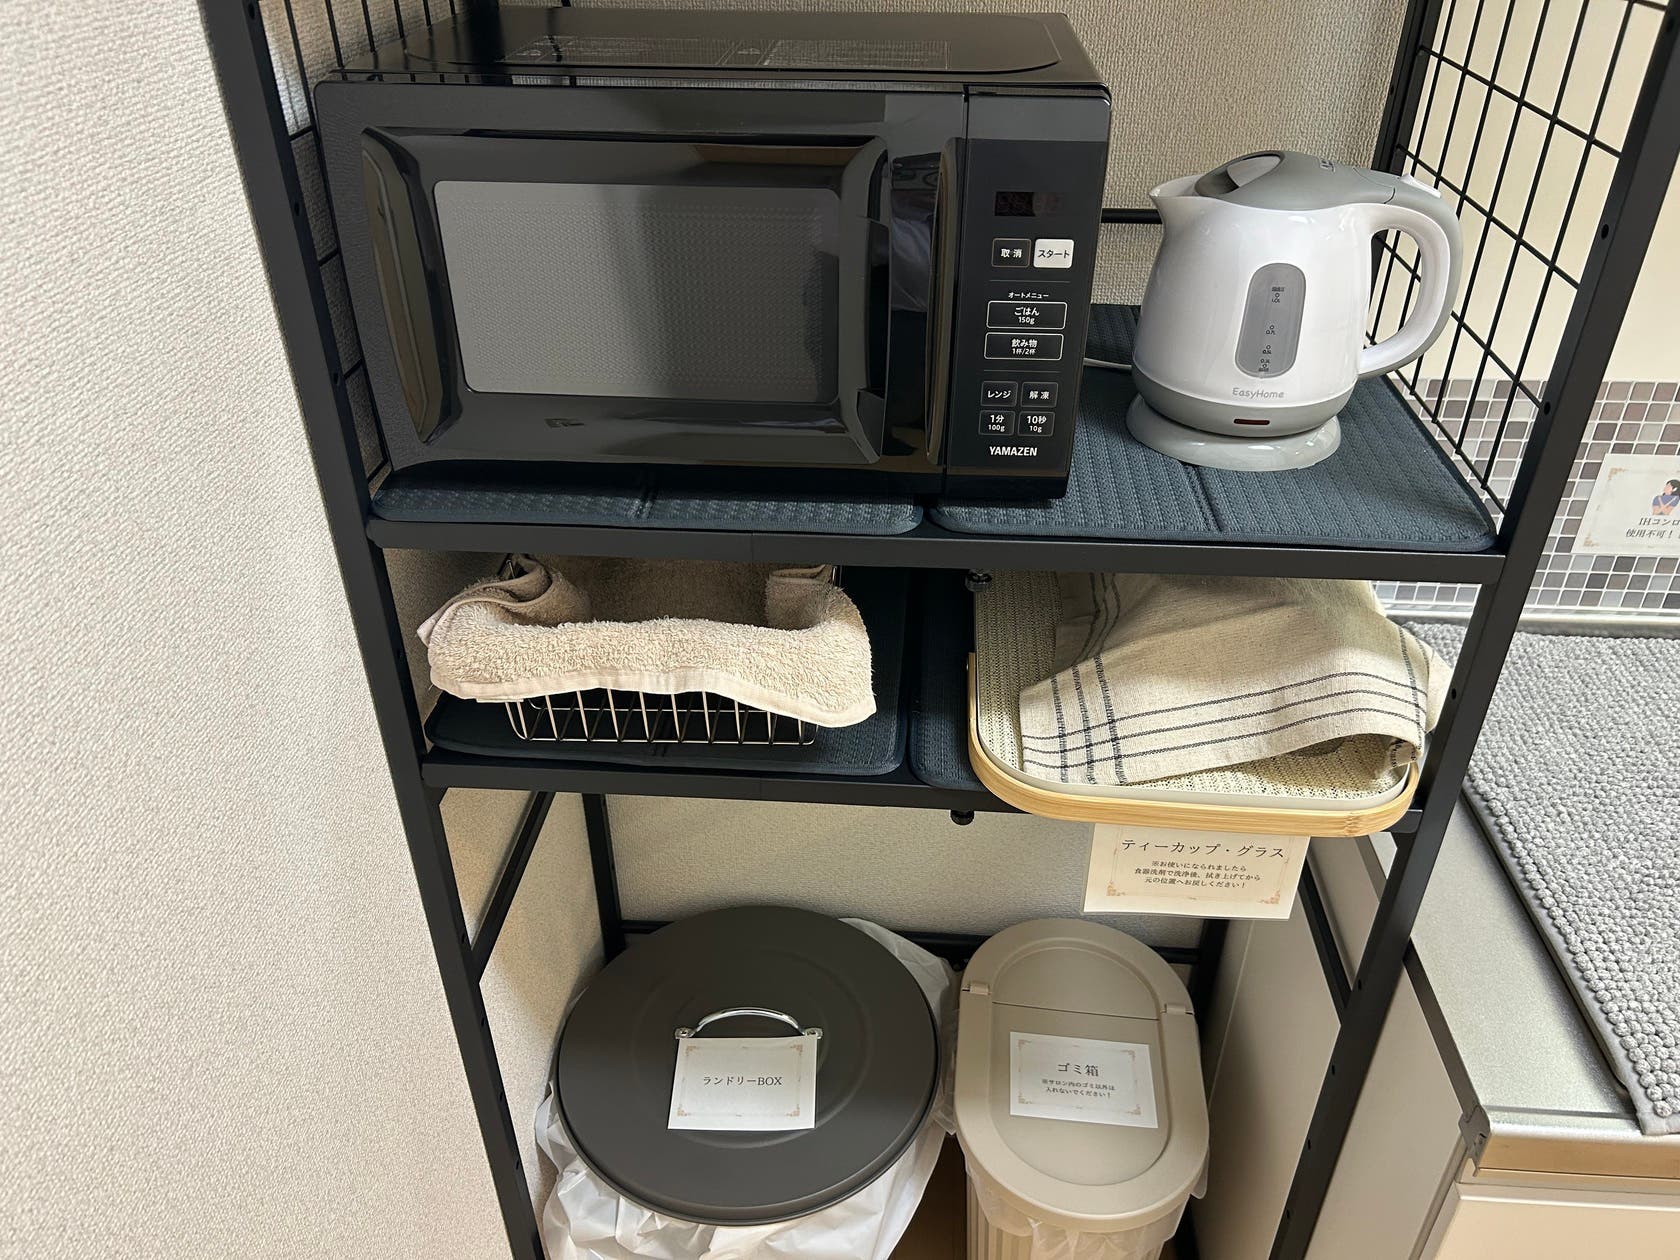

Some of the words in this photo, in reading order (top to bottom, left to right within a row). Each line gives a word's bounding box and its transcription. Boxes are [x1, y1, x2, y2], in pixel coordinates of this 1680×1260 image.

[1000, 248, 1022, 258] 取消
[1037, 249, 1070, 259] スタート
[1014, 307, 1040, 316] ごはん
[1018, 316, 1035, 325] 150g
[1011, 338, 1038, 348] 飲み物
[987, 390, 1011, 399] レンジ
[1029, 390, 1050, 400] 解凍
[1232, 387, 1285, 399] EasyHome
[990, 414, 1005, 423] 1分
[1026, 415, 1047, 425] 10秒
[988, 424, 1005, 432] 100g
[1029, 425, 1042, 433] 10g
[989, 446, 1038, 456] YAMAZEN
[1625, 528, 1680, 539] 使用不可！
[1121, 839, 1285, 858] ティーカップ・グラス
[1151, 860, 1247, 872] ※お使いになられましたら
[1144, 876, 1246, 889] 元の位置へお戻しください！
[1057, 1062, 1099, 1077] ゴミ箱
[703, 1076, 783, 1086] ランドリーBOX
